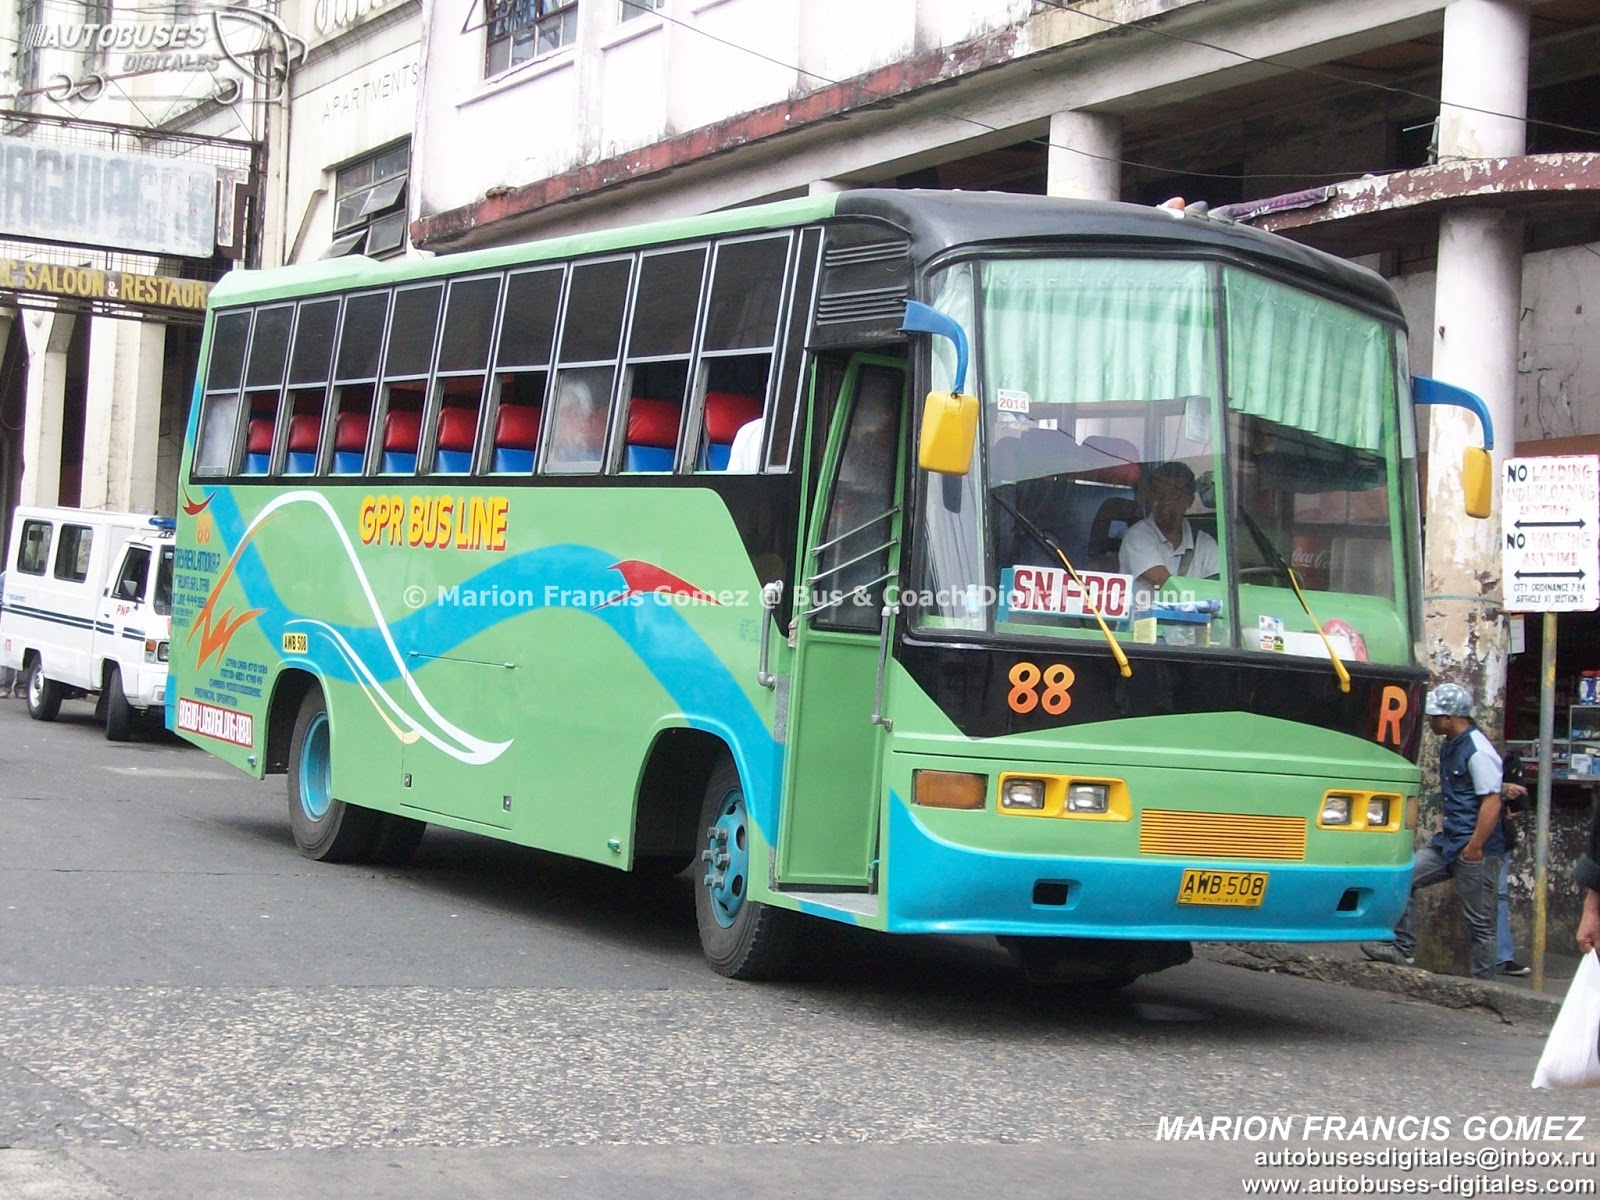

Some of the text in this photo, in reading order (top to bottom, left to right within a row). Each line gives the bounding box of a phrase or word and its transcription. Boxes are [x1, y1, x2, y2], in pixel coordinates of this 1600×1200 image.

[321, 62, 419, 125] APARTMENTS
[24, 262, 104, 297] SALOON
[107, 281, 119, 297] &
[1000, 397, 1026, 410] 2014
[1507, 464, 1528, 483] NO
[359, 495, 509, 551] GPR BUS LINE
[1506, 532, 1526, 550] NO
[1513, 583, 1528, 592] CITY
[1531, 583, 1569, 592] ORDINANCE
[116, 604, 131, 617] PNP
[1008, 662, 1075, 715] 88
[1377, 685, 1408, 745] R
[1183, 874, 1264, 896] AWB 508
